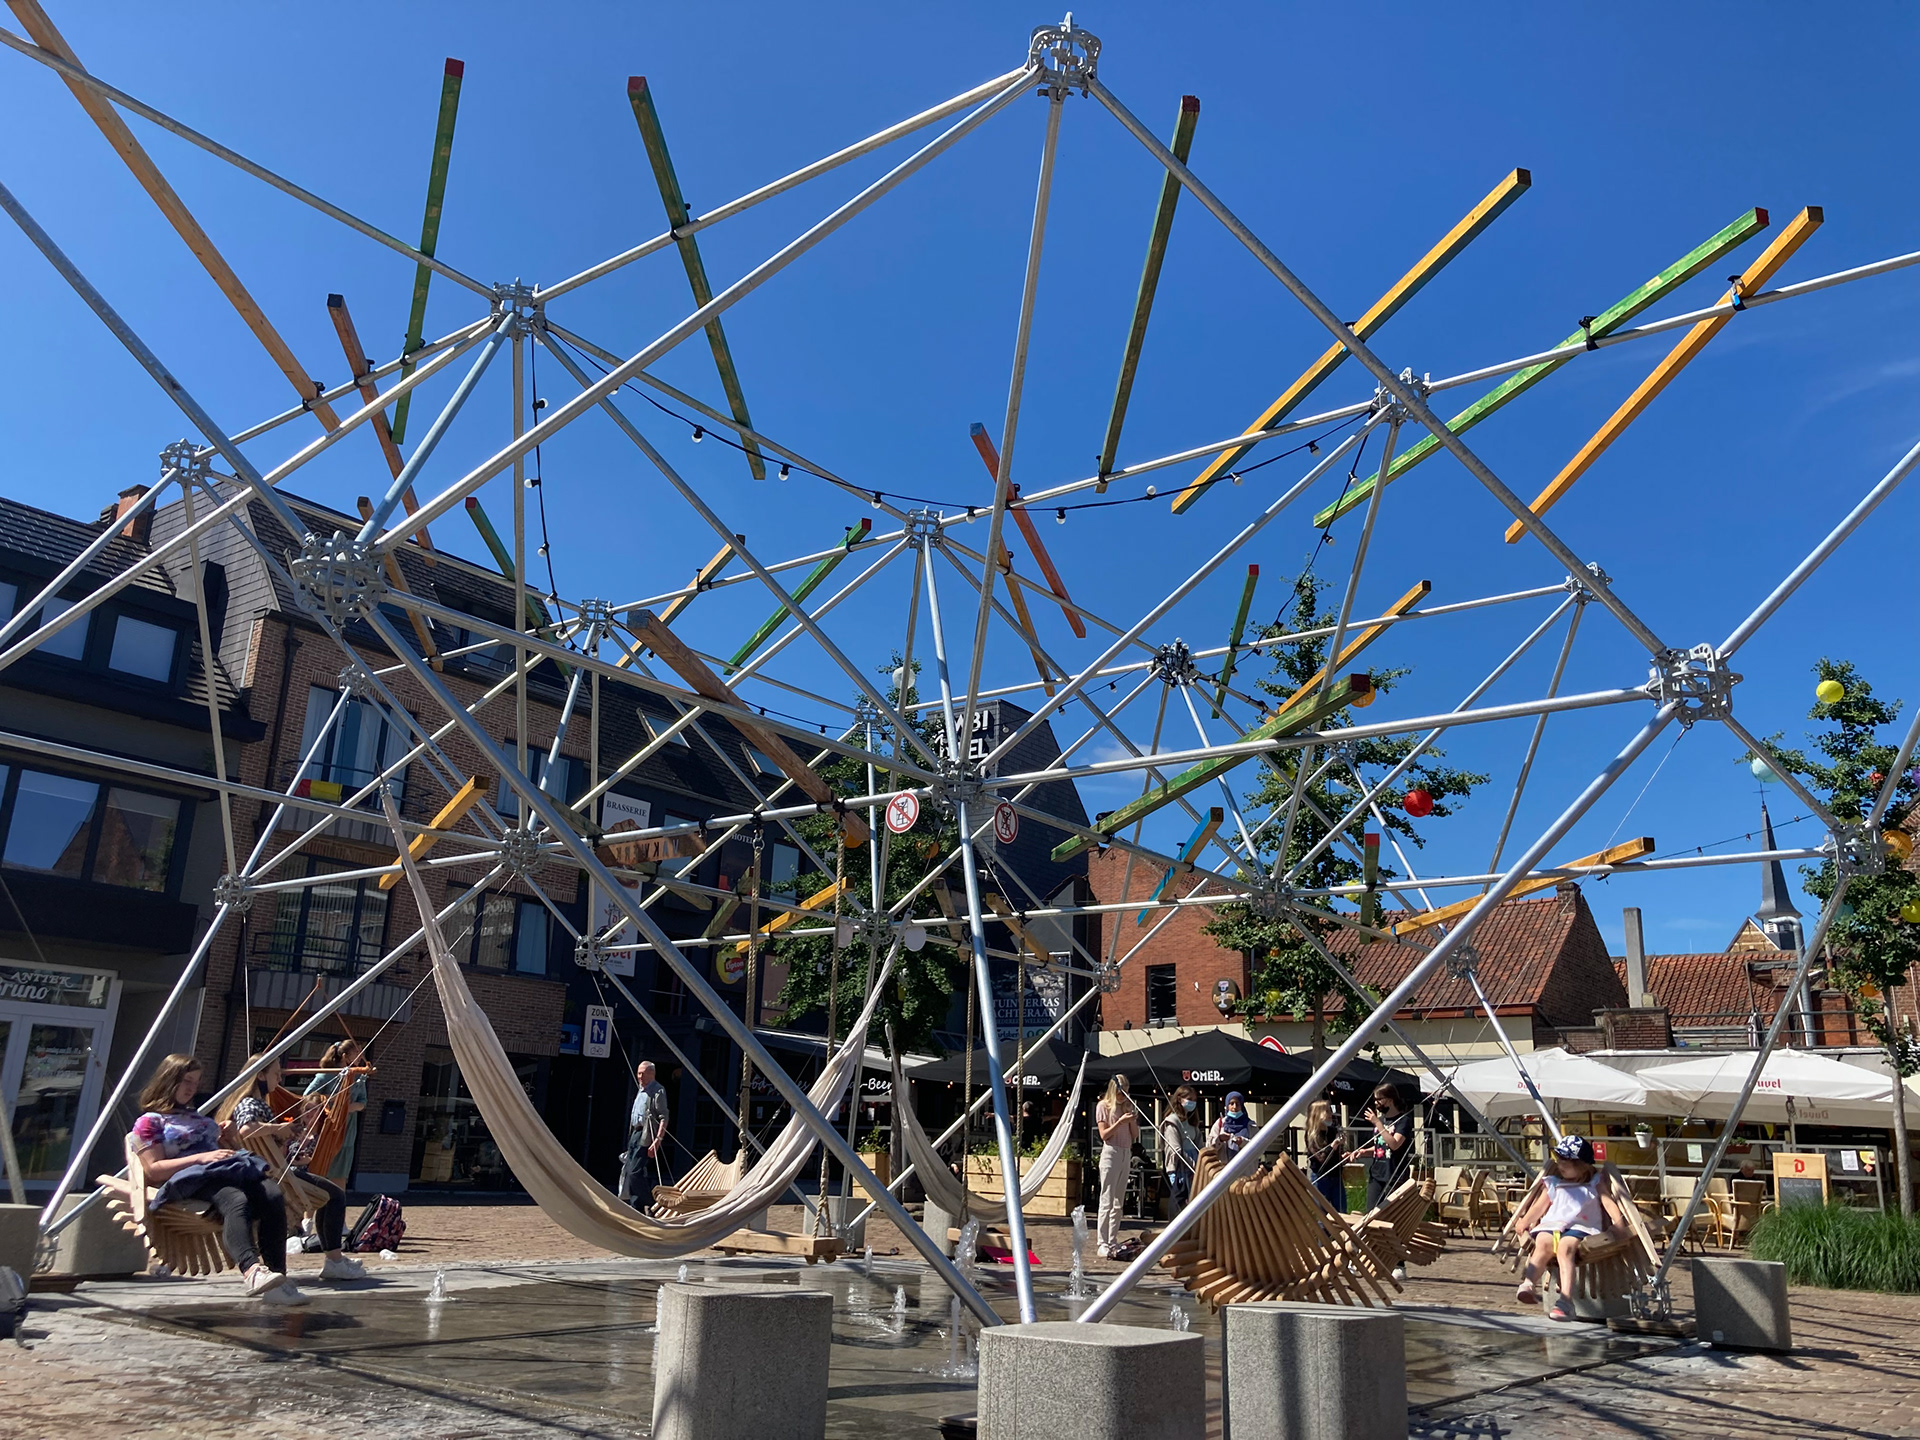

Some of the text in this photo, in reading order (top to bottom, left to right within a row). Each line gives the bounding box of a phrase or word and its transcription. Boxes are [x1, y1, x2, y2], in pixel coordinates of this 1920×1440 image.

[606, 800, 647, 817] BRASSERIE
[731, 834, 753, 845] HOTEL
[725, 961, 745, 970] Lipton
[11, 971, 74, 988] ANTIEK
[0, 976, 50, 1000] runo
[992, 997, 1060, 1008] TUINERRAS
[591, 1008, 610, 1018] ZONE
[1757, 1078, 1781, 1089] uvel
